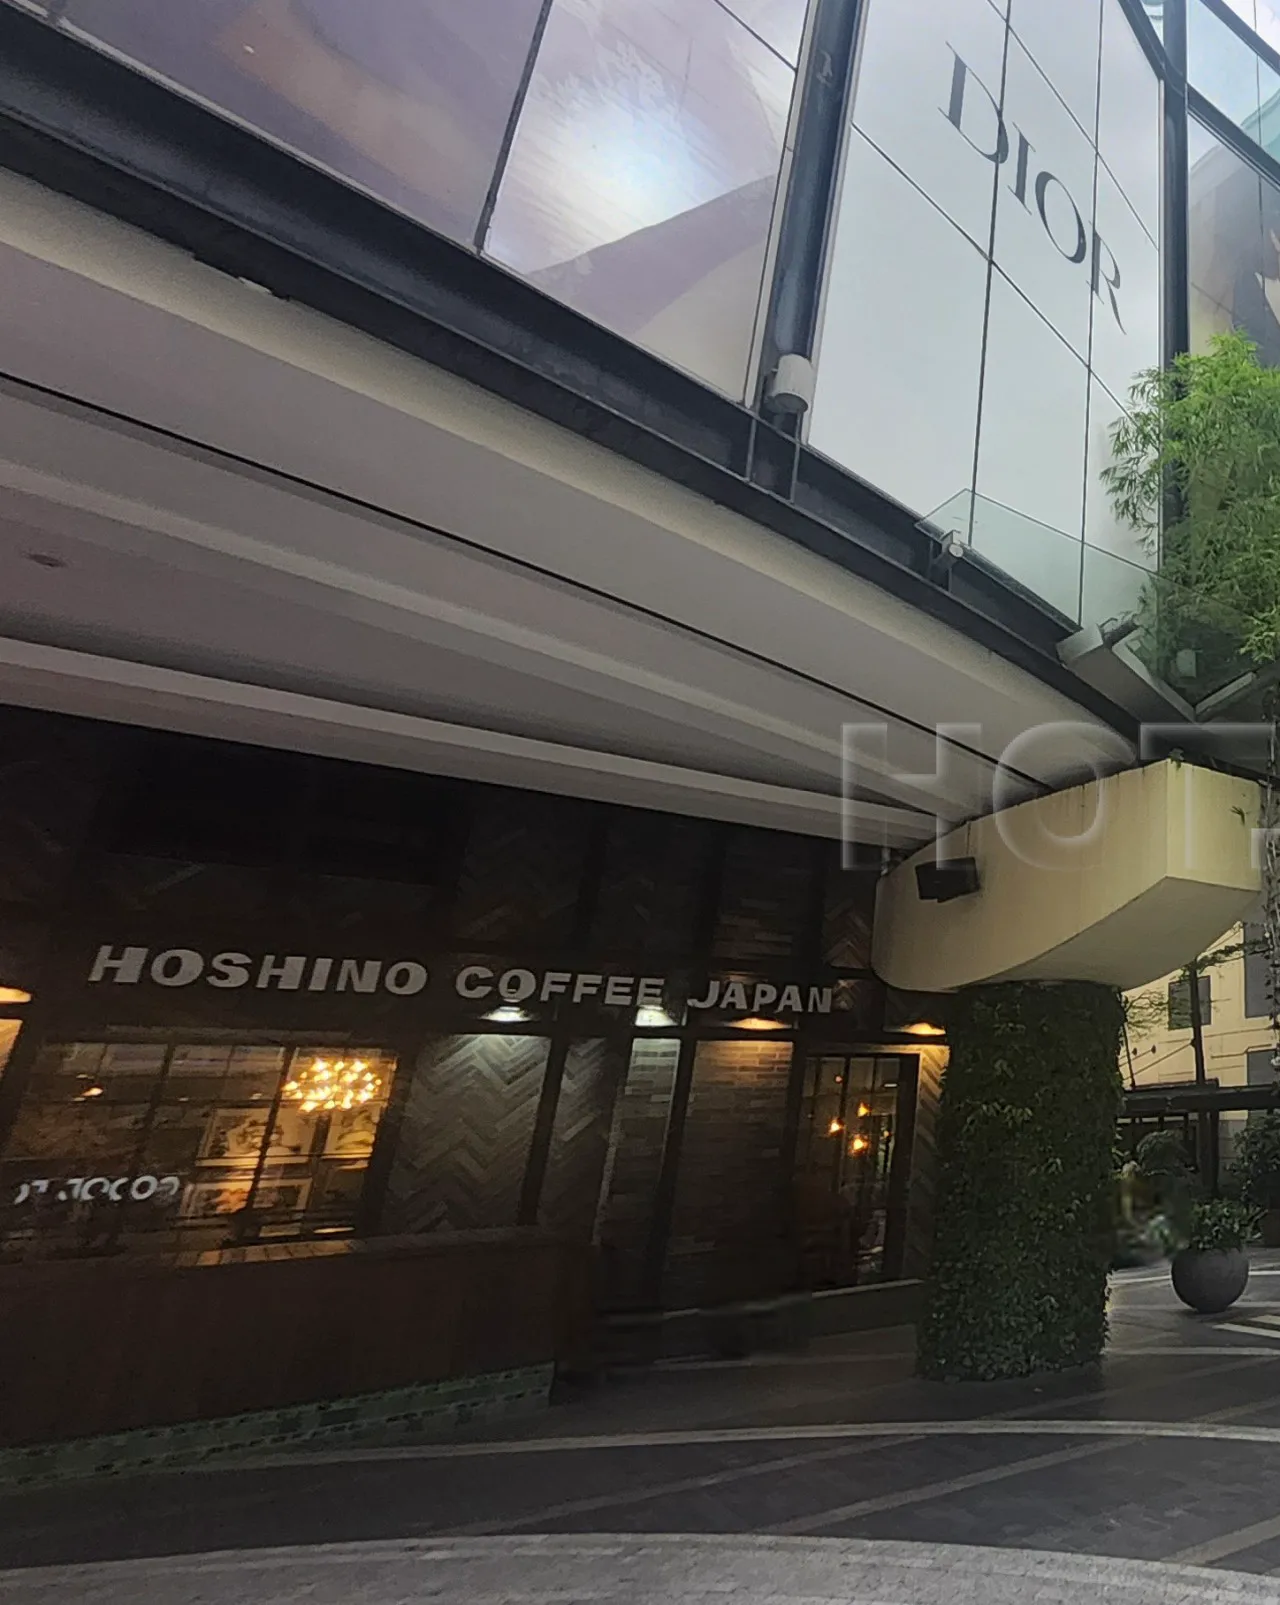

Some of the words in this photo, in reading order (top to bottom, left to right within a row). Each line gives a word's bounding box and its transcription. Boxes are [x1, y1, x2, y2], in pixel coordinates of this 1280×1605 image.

[937, 41, 1127, 335] DIOR
[88, 945, 428, 995] HOSHINO
[455, 966, 665, 1006] COFFEE
[686, 980, 833, 1013] JAPAN
